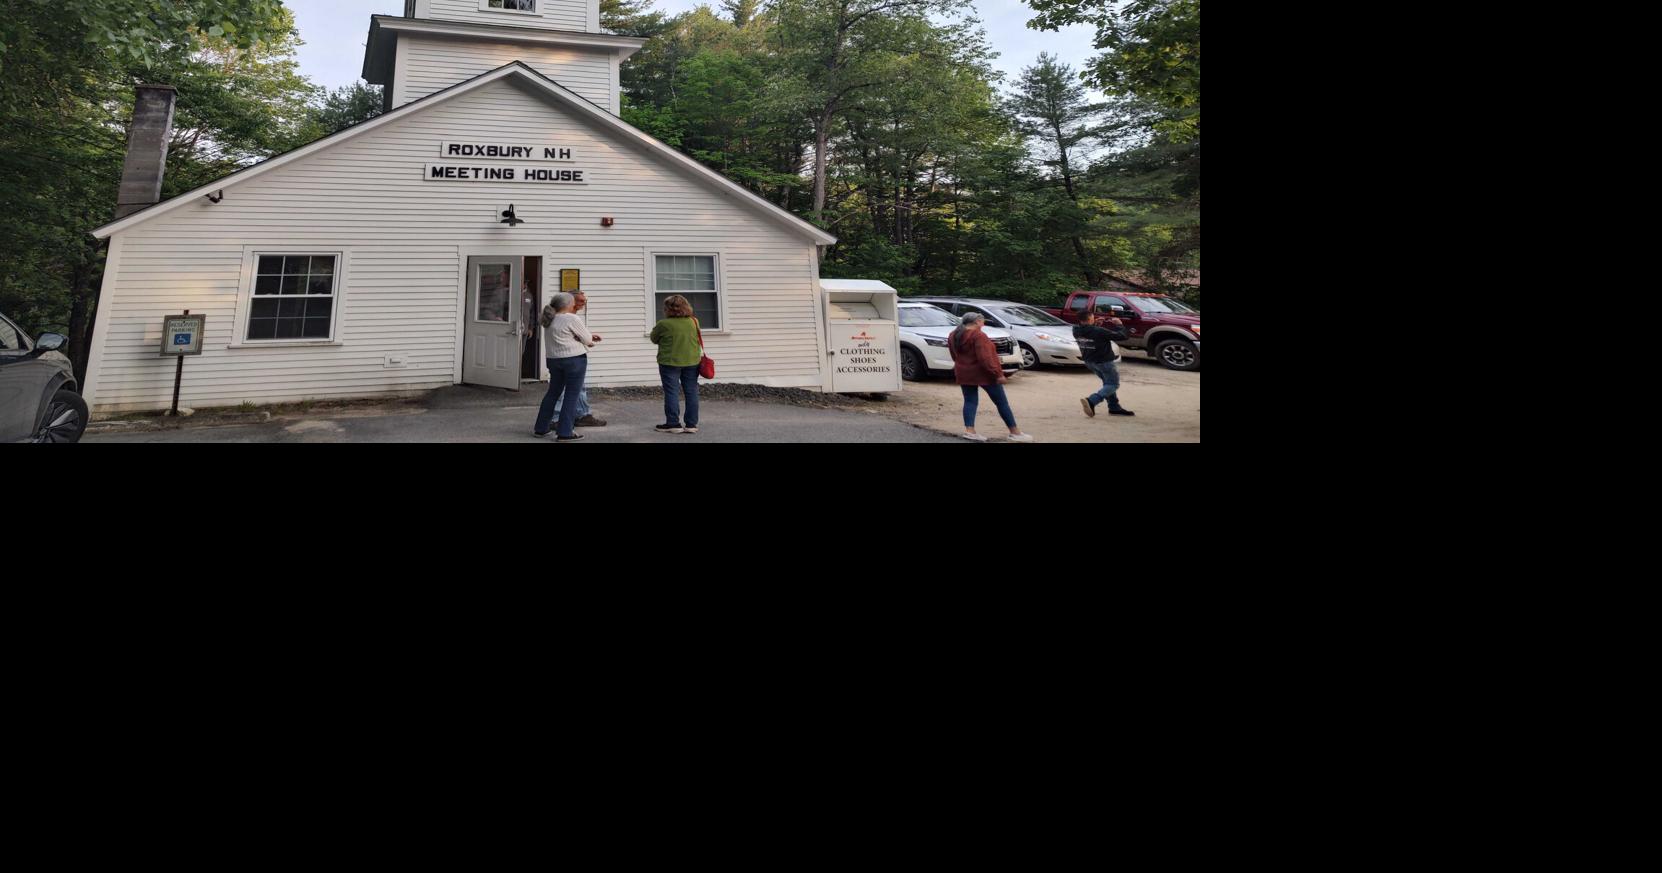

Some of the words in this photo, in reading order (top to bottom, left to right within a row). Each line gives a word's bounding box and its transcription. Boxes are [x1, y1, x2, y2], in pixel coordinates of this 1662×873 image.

[448, 144, 533, 158] ROXBURY
[431, 166, 515, 180] MEETING
[524, 169, 584, 182] HOUSE
